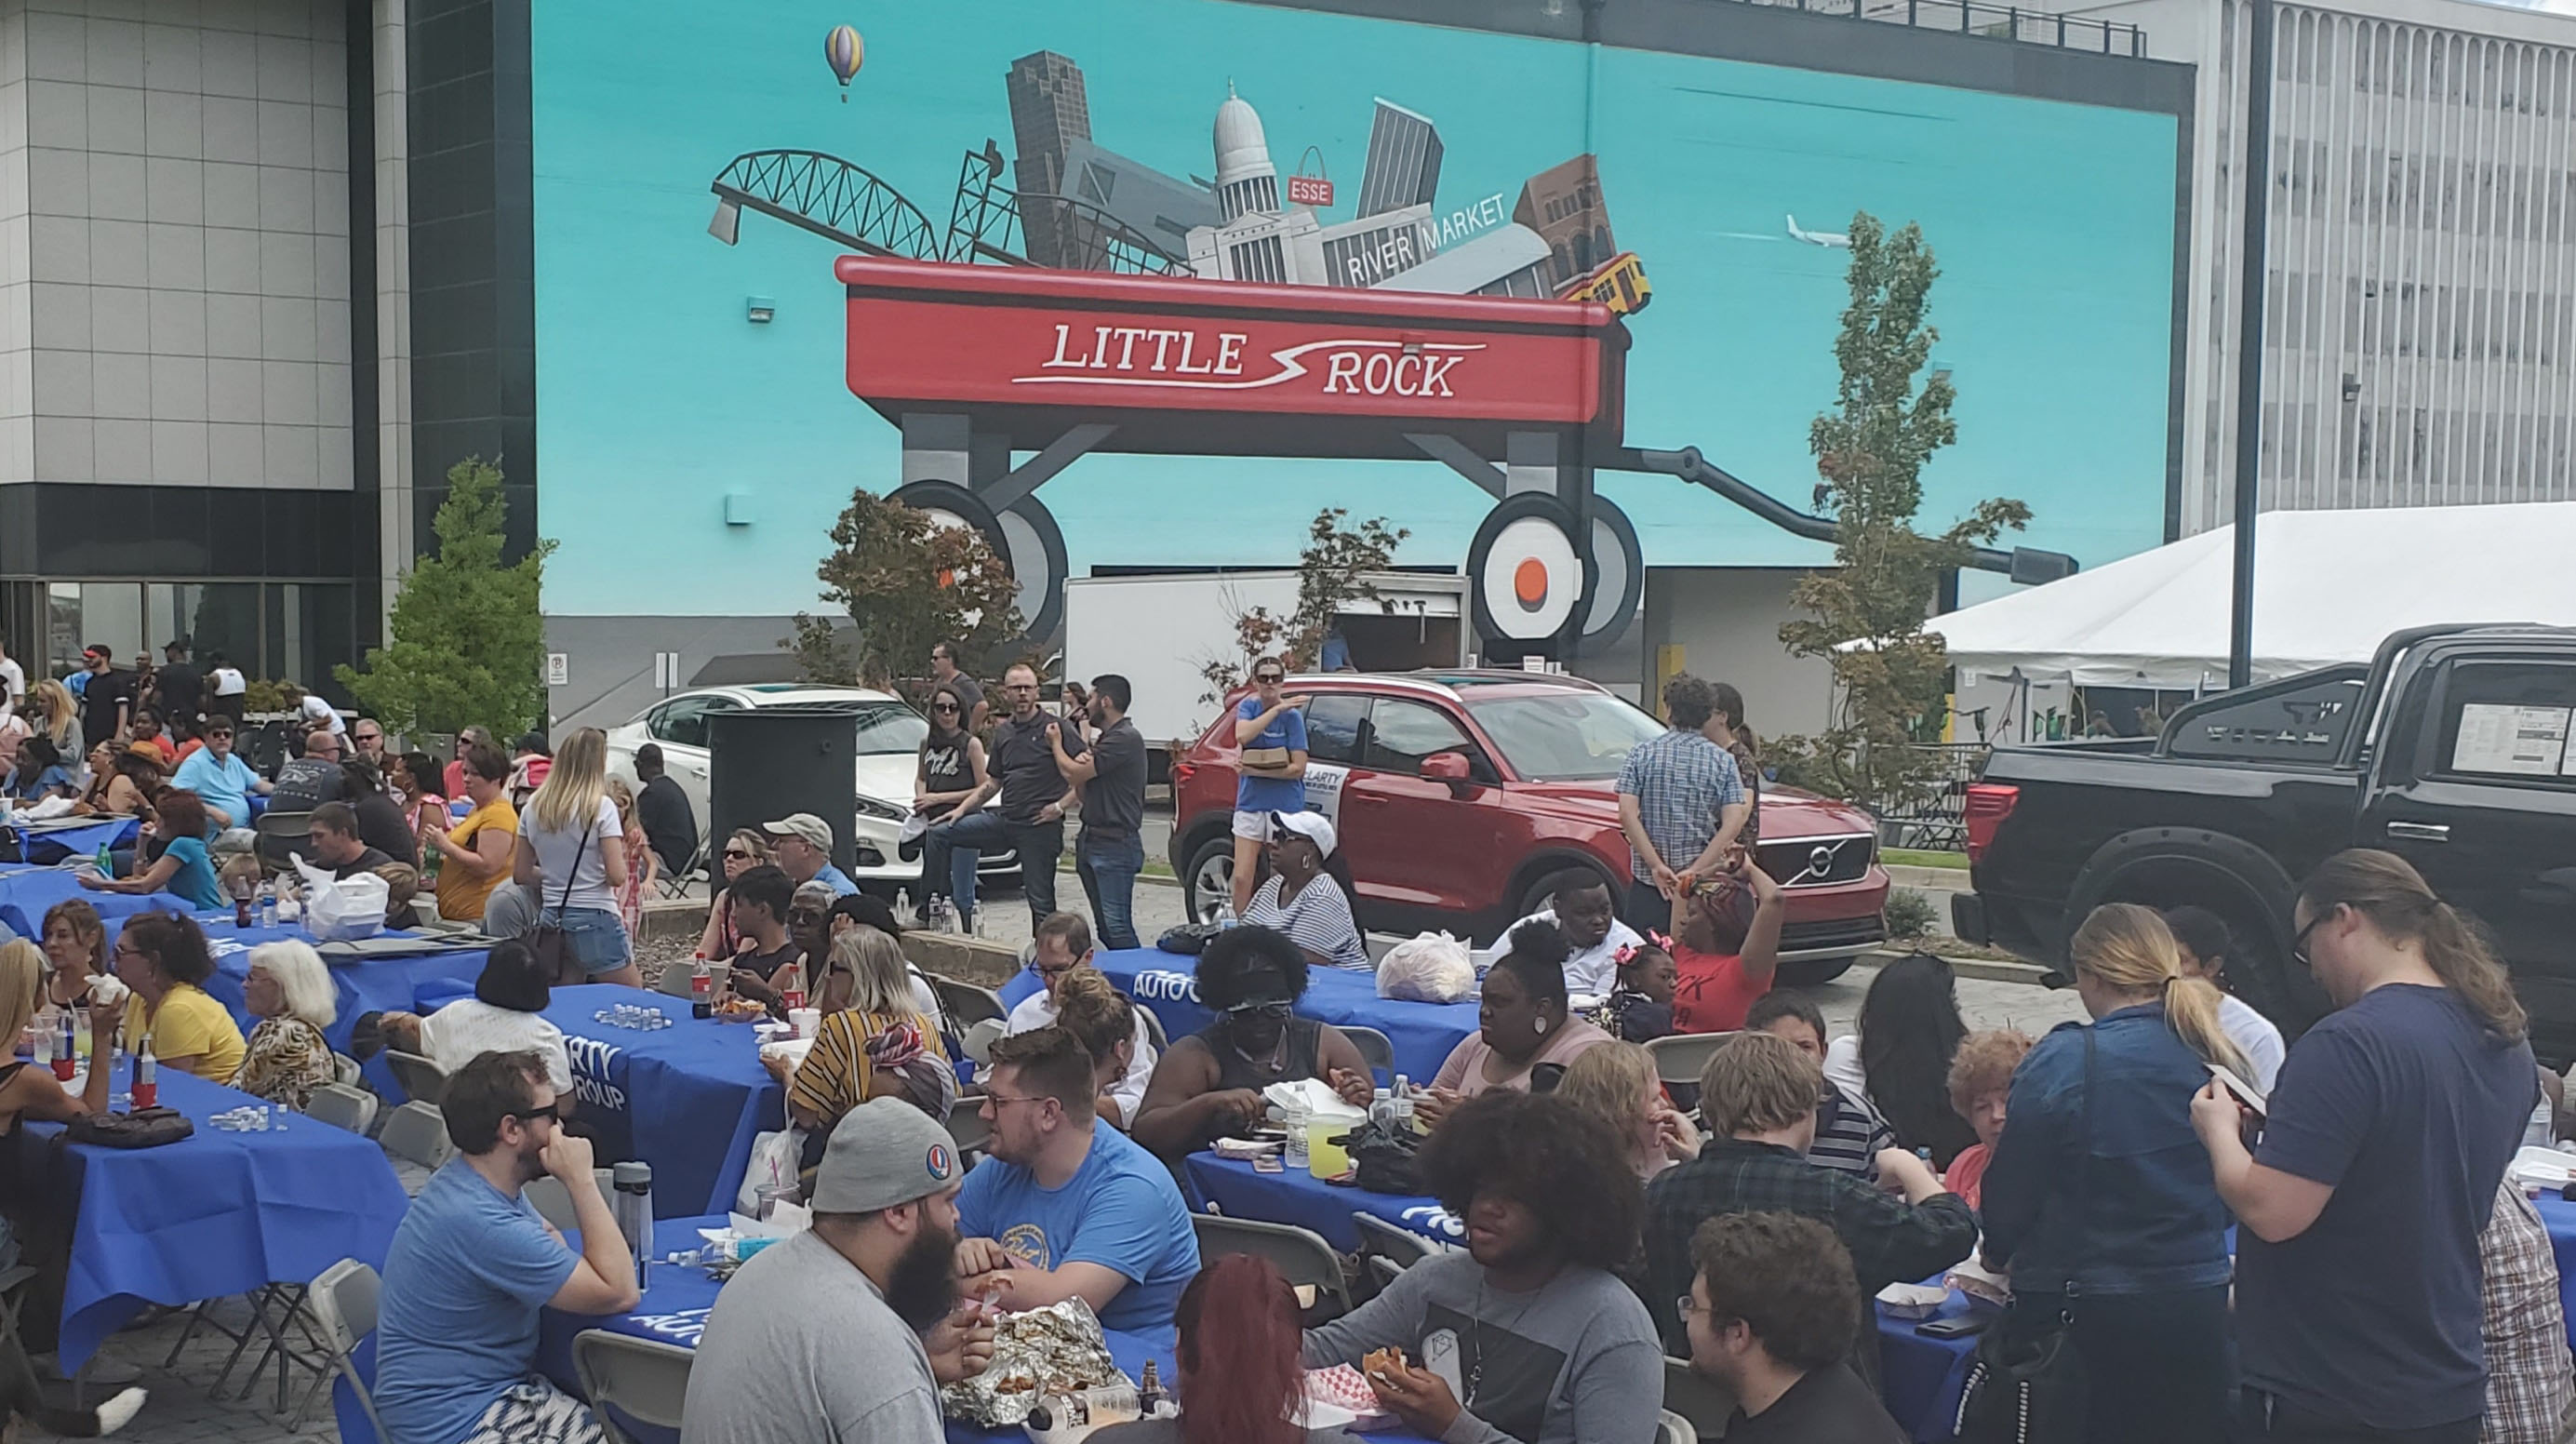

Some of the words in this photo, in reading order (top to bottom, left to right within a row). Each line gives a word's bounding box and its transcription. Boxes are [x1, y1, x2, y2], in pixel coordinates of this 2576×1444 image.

[1291, 180, 1329, 202] ESSE
[1347, 235, 1412, 283] RIVER
[1421, 194, 1505, 252] MARKET
[1042, 324, 1248, 375] LITTLE
[1323, 351, 1464, 397] ROCK
[1302, 769, 1342, 784] LARTY
[562, 1035, 623, 1081] RTY
[572, 1074, 626, 1111] ROUP
